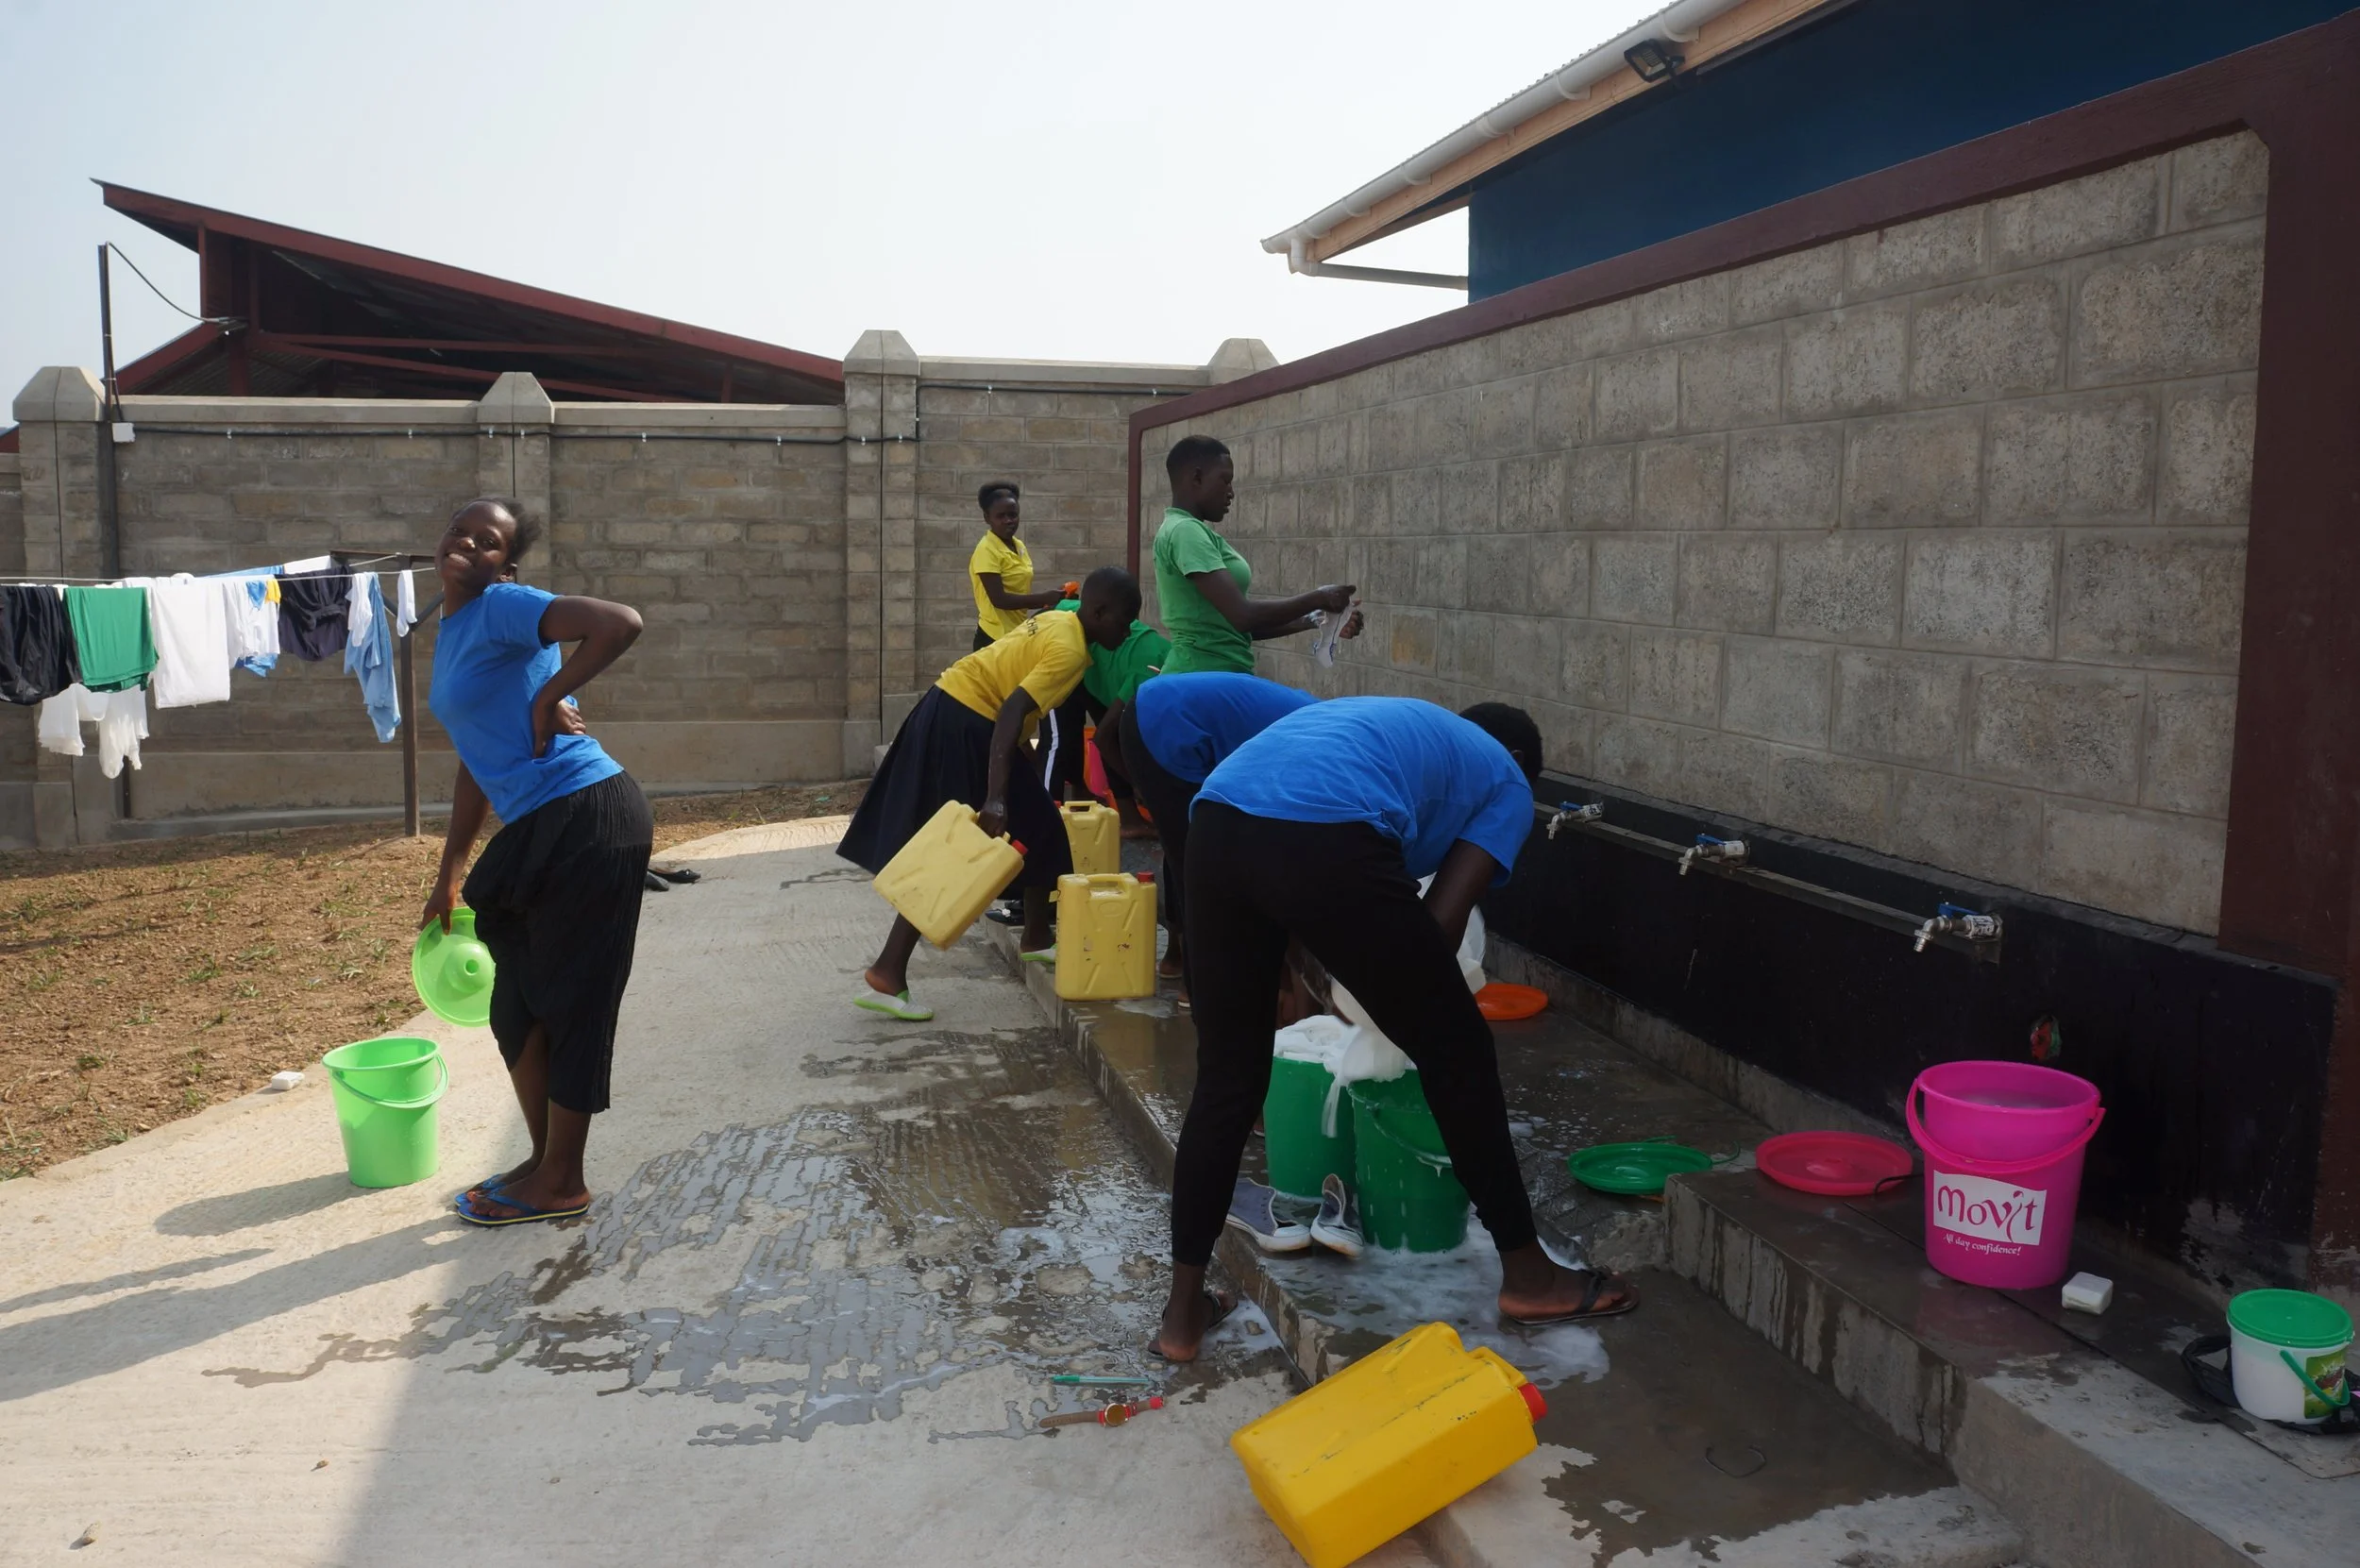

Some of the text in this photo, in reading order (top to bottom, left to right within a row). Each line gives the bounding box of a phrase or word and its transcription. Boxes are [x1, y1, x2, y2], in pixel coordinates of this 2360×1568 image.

[1944, 1233, 2022, 1256] All day confidence!
